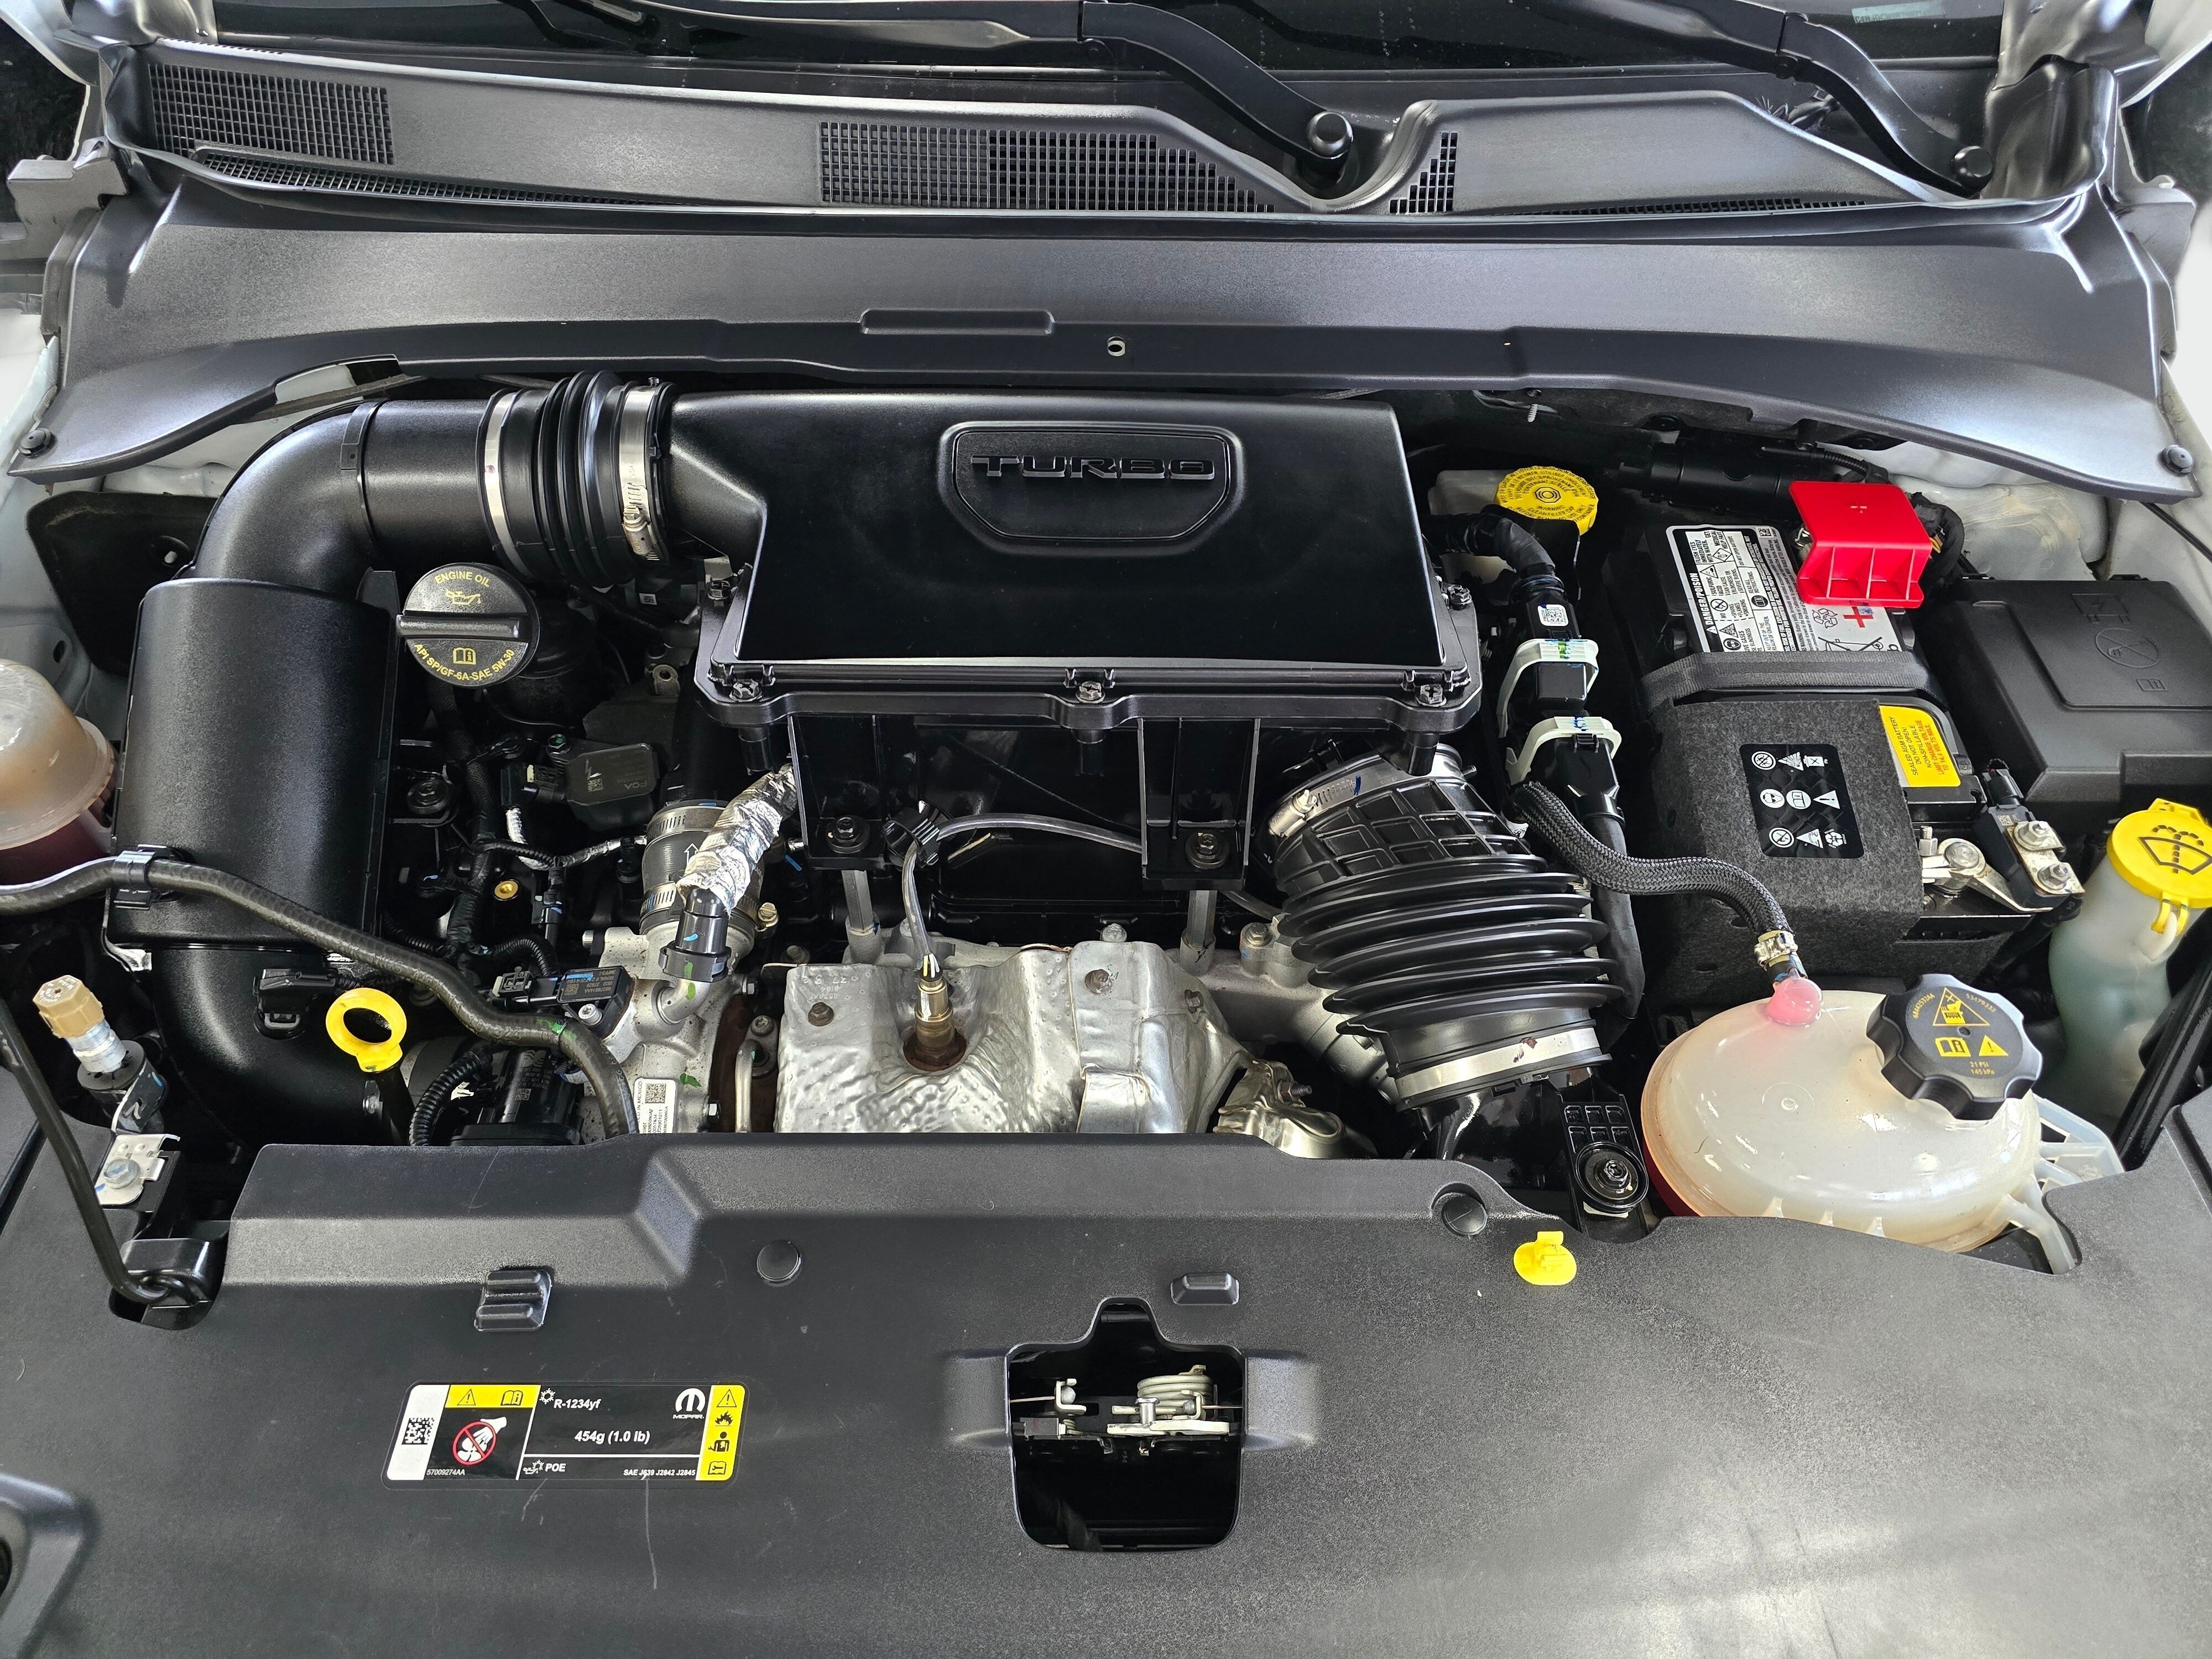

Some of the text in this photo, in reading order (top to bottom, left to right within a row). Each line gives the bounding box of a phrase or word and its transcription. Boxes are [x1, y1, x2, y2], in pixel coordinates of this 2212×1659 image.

[971, 454, 1215, 479] TURBO
[1527, 507, 1547, 516] CLEAN
[1710, 531, 1720, 546] MEDICAL
[1695, 539, 1707, 563] IMMEDIATELY
[435, 571, 490, 588] ENGINE OIL
[1706, 577, 1717, 594] SULFURIC
[1726, 576, 1736, 593] BLINDNESS
[1735, 580, 1743, 592] SEVERE
[1689, 572, 1714, 625] DANGER/POISON
[1771, 587, 1780, 599] FOLLOW
[1772, 606, 1782, 624] EXPLOSION
[1739, 631, 1747, 643] GASES
[1745, 628, 1755, 646] BLINDNESS
[1785, 628, 1796, 651] ECOMMENDED
[1797, 633, 1806, 647] WARNING:
[414, 643, 515, 681] API SP/GF-6A-SAE 5W-30
[1889, 716, 1918, 775] SEALED AGM BATTERY
[1908, 744, 1917, 755] NOT
[1910, 725, 1932, 768] NON-SPILLABLE
[1915, 720, 1944, 775] LIMIT CHARGE VOLTAGE
[1930, 737, 1941, 752] VOLTS
[1937, 753, 1945, 763] 14.4
[624, 780, 647, 790] FCA
[553, 1399, 602, 1411] R-1234yf
[574, 1431, 651, 1444] 454g (1.0 lb)
[545, 1463, 566, 1472] POE
